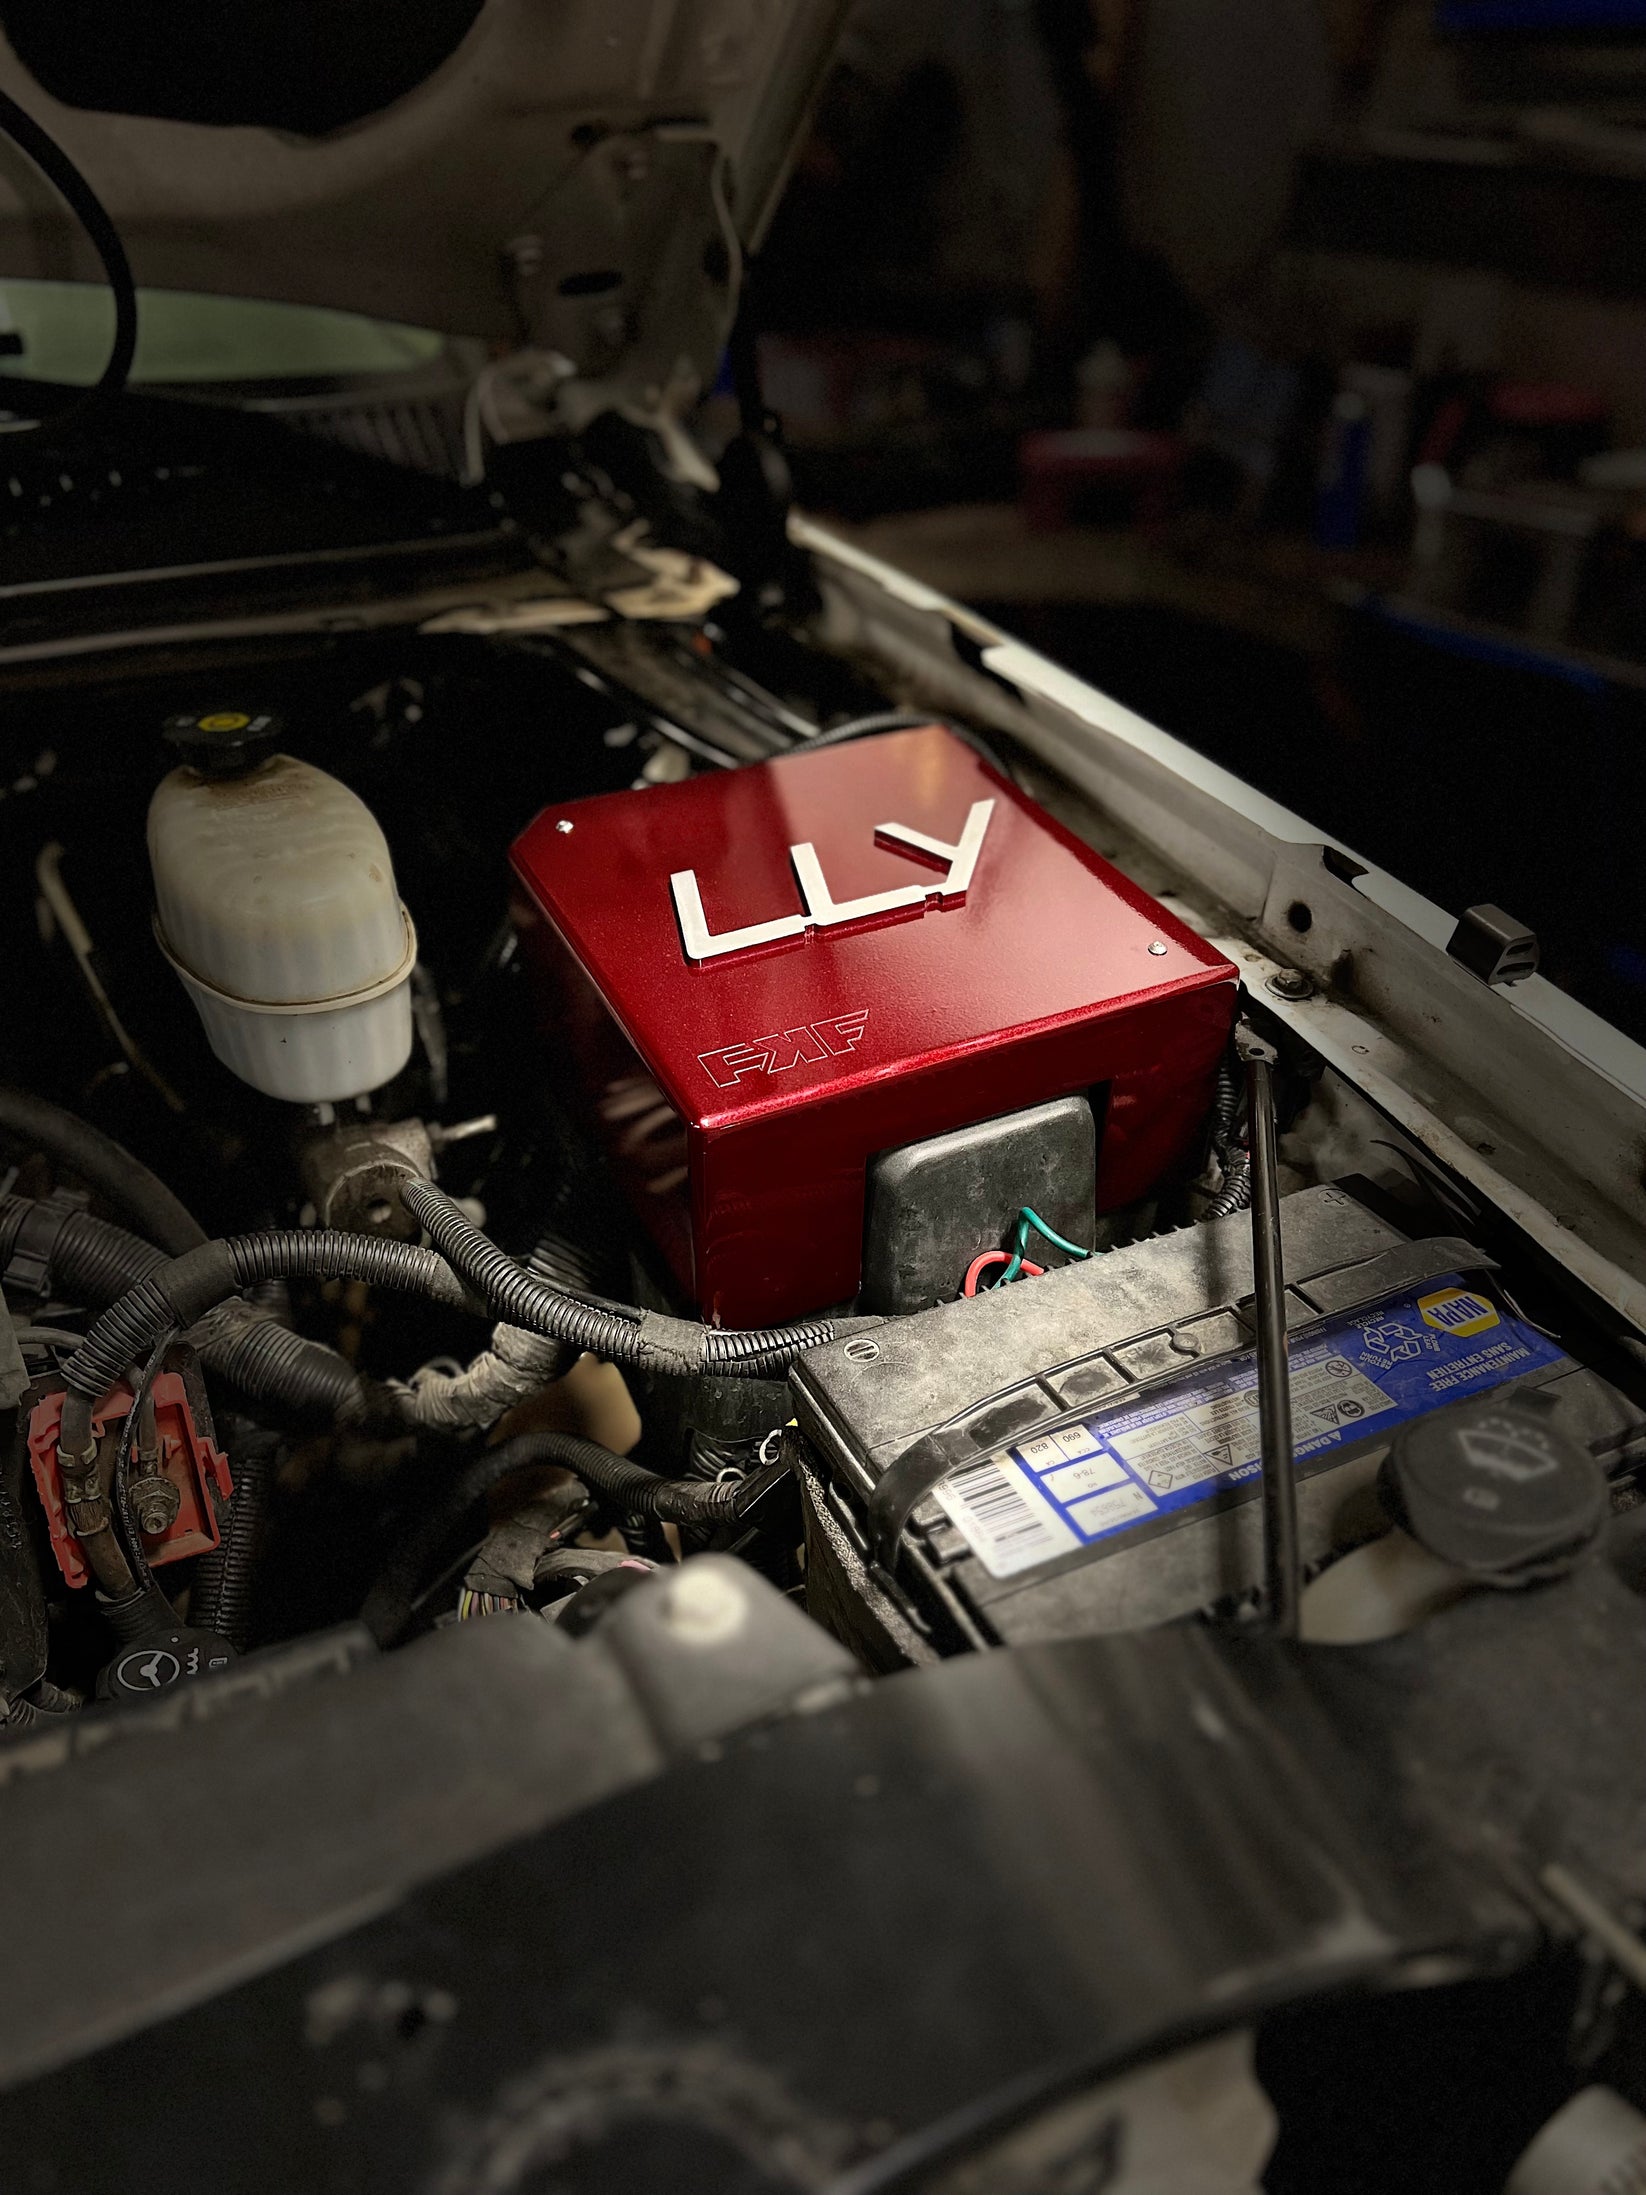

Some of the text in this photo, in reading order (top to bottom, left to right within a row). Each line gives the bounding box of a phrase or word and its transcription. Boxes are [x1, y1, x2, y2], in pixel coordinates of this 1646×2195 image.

[671, 798, 995, 962] LLY
[1346, 1309, 1384, 1326] RECYCLAGE
[1354, 1315, 1384, 1328] RECYCLE
[1427, 1295, 1488, 1328] NAPA
[1360, 1351, 1392, 1365] RETURN
[1425, 1341, 1513, 1379] SANS ENTRETIEN
[1427, 1347, 1531, 1391] MAINTENANCE FREE
[1031, 1431, 1080, 1454] 690 820
